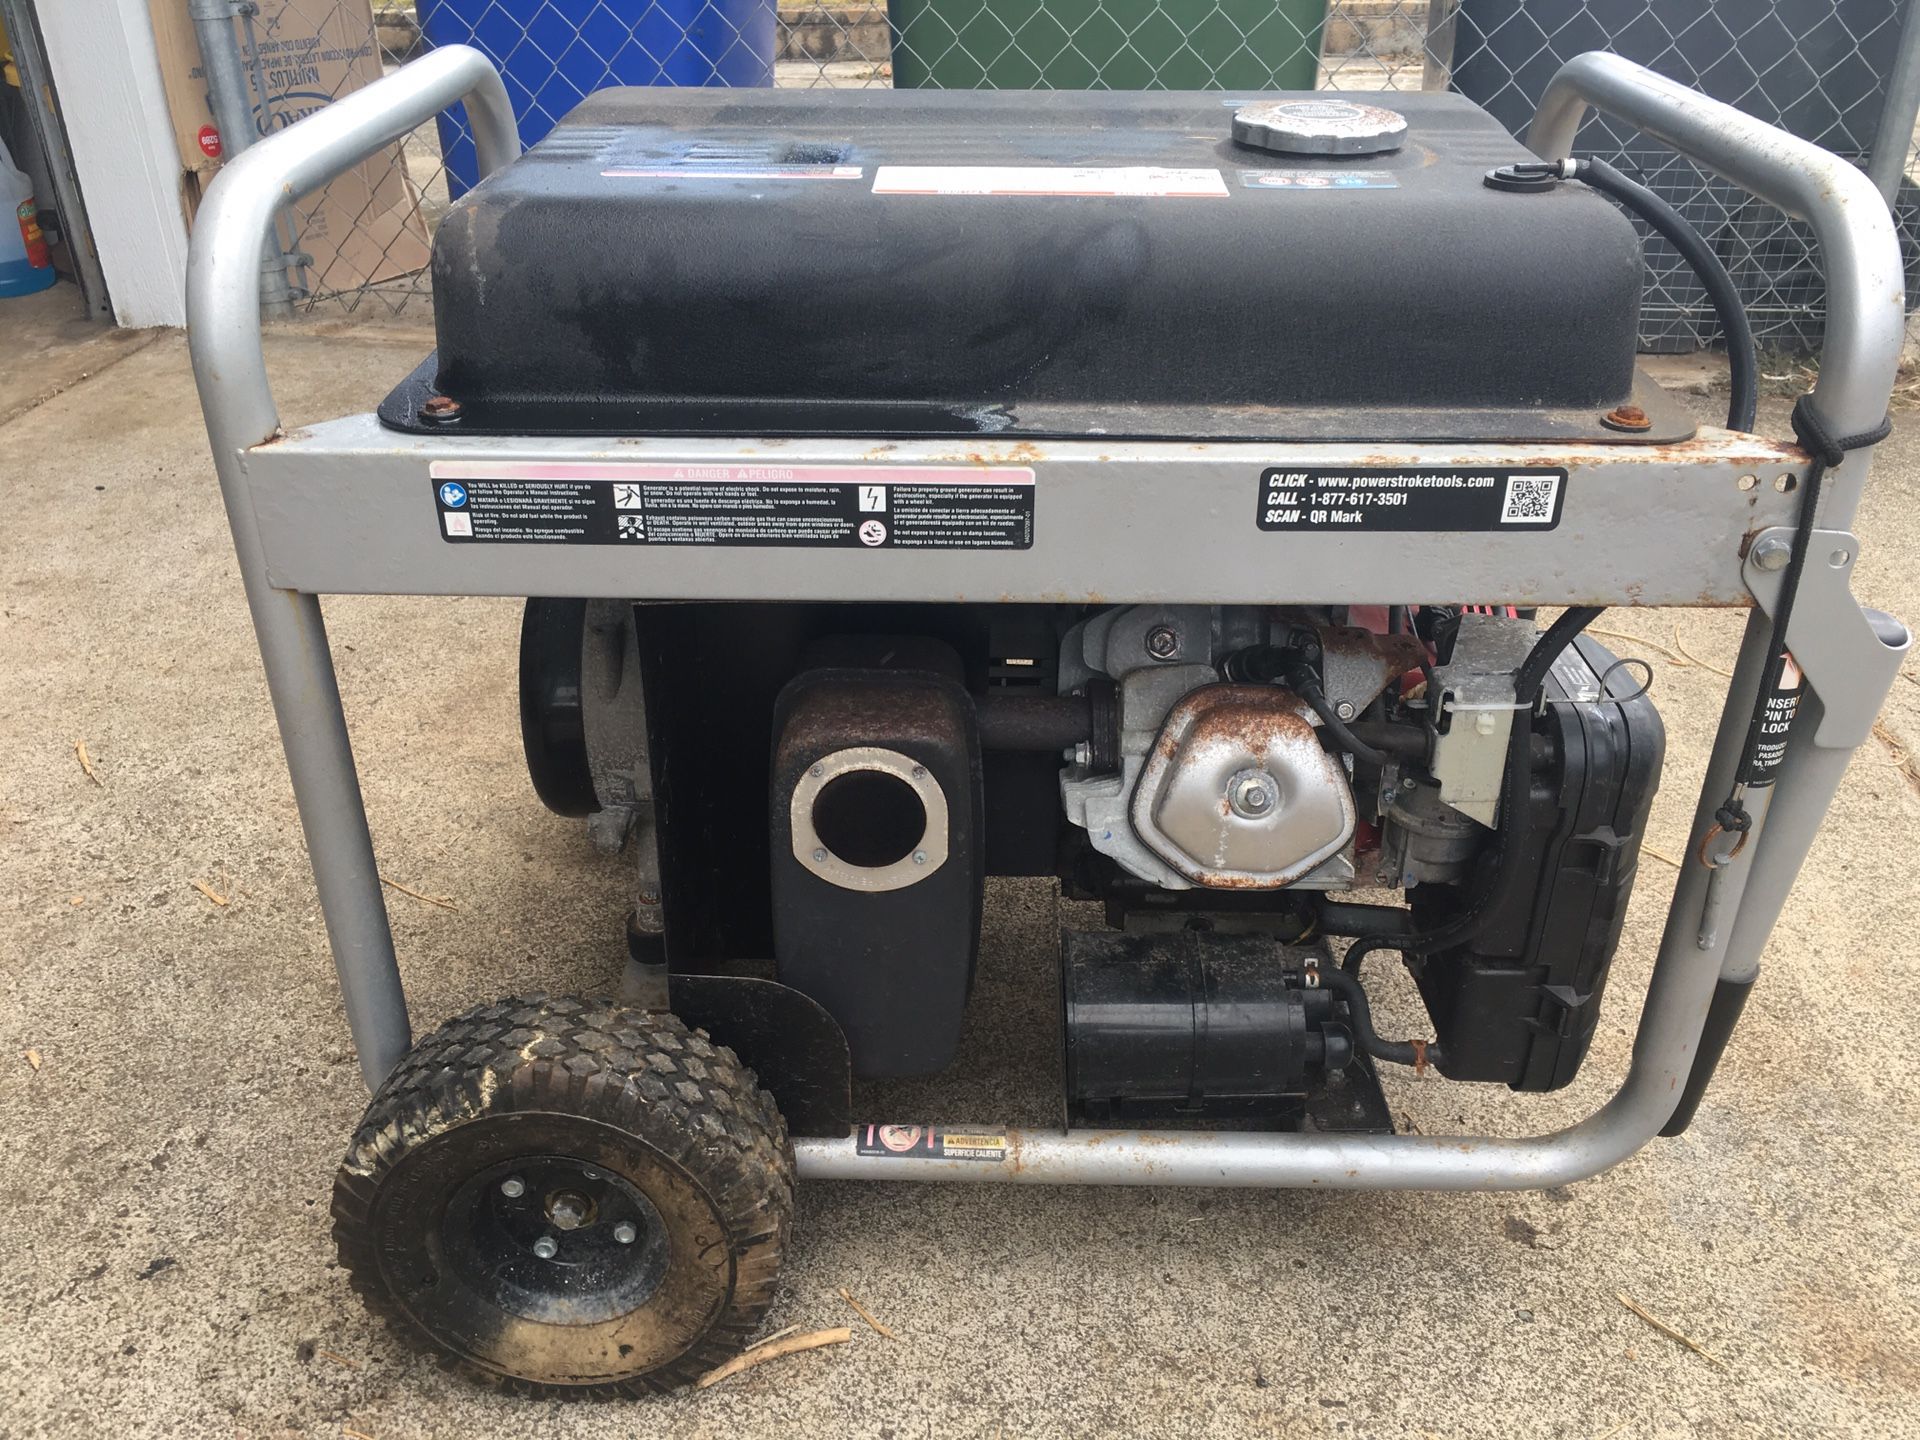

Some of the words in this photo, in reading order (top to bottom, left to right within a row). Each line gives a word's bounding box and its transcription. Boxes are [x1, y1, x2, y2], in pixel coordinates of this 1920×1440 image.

[688, 469, 729, 478] DANGER
[749, 469, 793, 479] PELIGRO
[1269, 474, 1306, 488] CLICK
[1318, 475, 1494, 489] www.powerstroketools.com
[1267, 493, 1297, 505] CALL
[1310, 493, 1408, 505] 1-877-617-3501
[1265, 510, 1299, 522] SCAN
[1310, 511, 1327, 523] QR
[1330, 511, 1362, 523] Mark
[1767, 695, 1800, 709] NSERT
[1785, 708, 1796, 718] TO
[1761, 721, 1790, 733] LOCK
[956, 1136, 1000, 1146] ADVERTENCIA
[944, 1149, 975, 1157] SUPERFICIE
